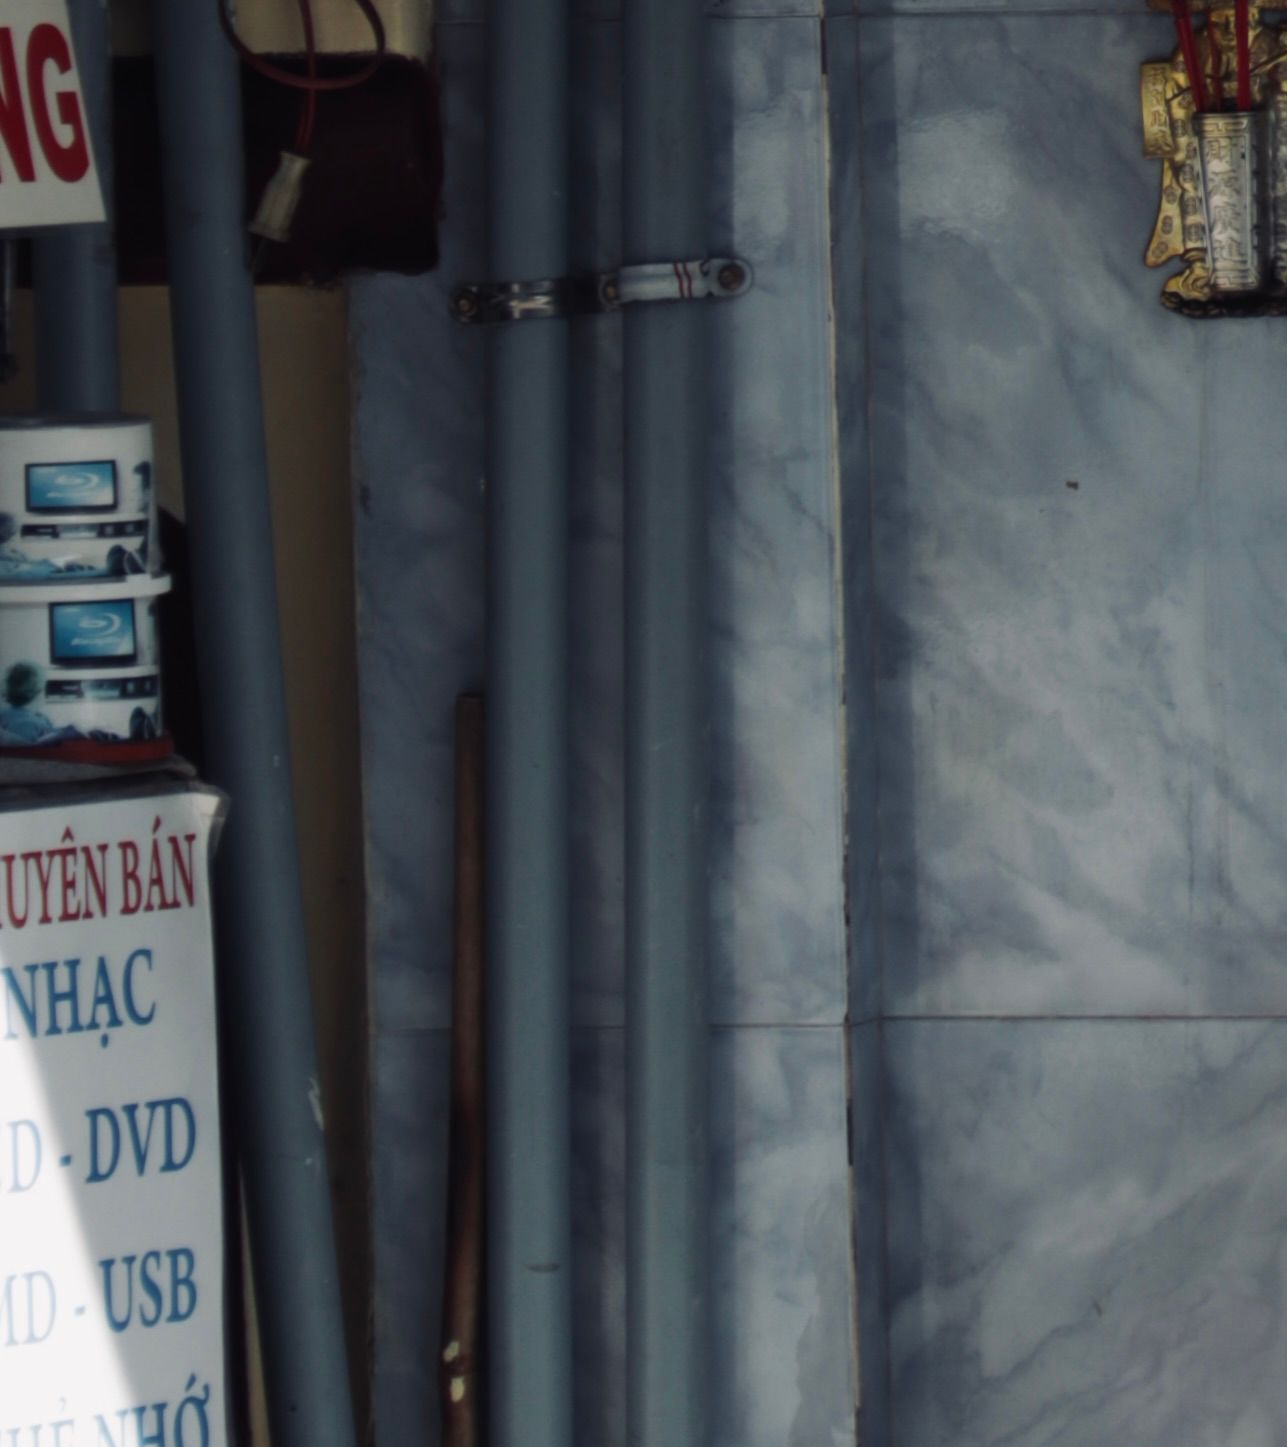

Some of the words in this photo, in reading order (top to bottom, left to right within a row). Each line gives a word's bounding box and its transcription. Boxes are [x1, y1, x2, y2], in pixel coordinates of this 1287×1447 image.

[119, 816, 199, 914] BÁN
[84, 1095, 199, 1187] DVD
[99, 1244, 200, 1335] USB
